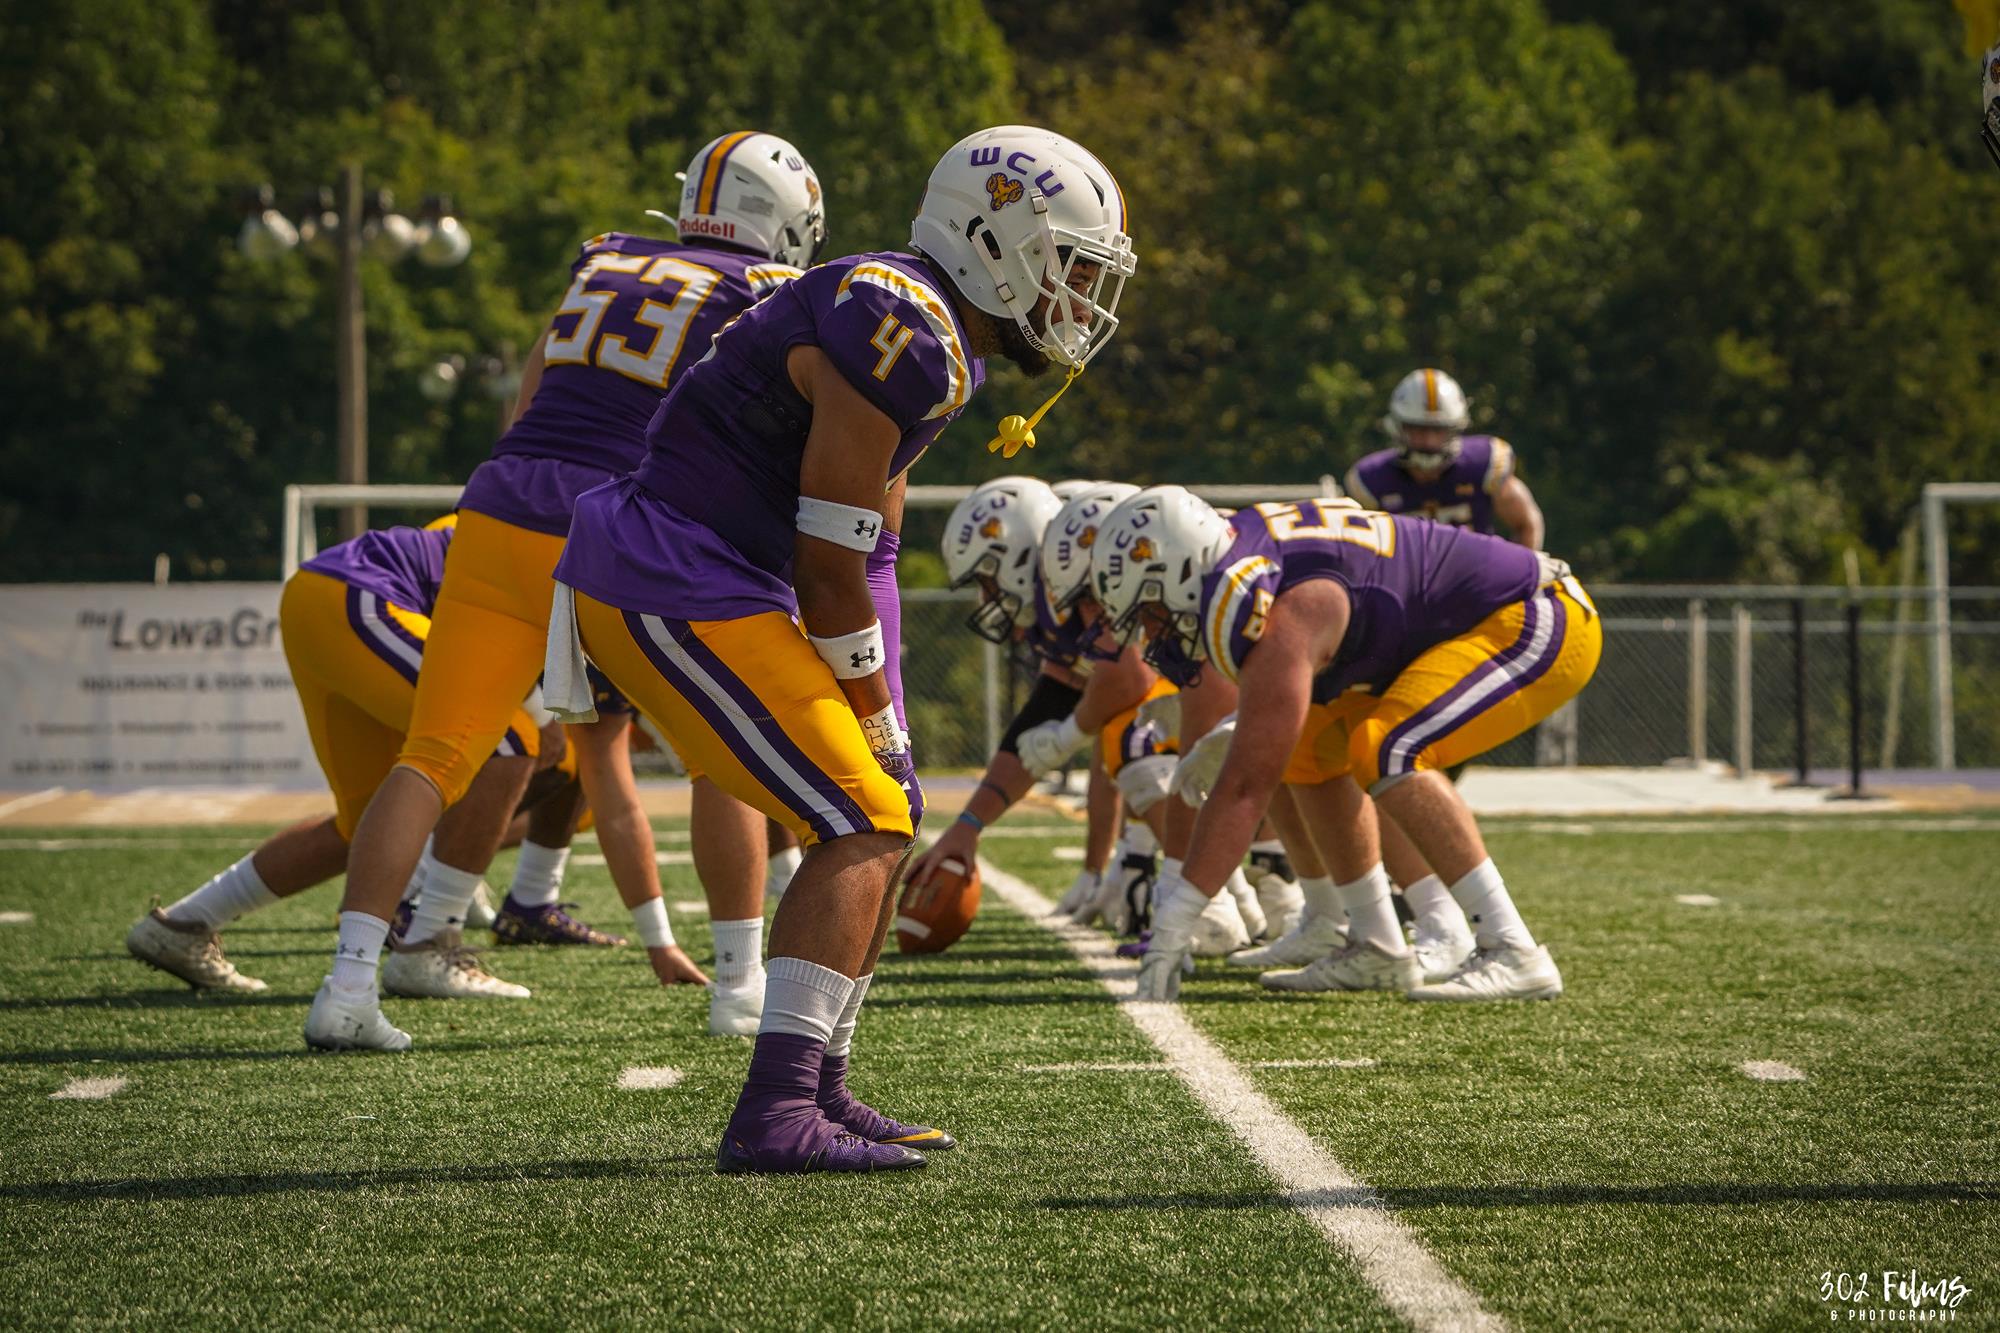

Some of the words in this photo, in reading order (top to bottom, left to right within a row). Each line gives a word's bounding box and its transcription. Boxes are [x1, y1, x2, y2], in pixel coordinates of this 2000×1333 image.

[970, 146, 1065, 198] WCU
[679, 218, 735, 239] Riddell
[544, 252, 724, 388] 53
[870, 312, 914, 382] 4
[958, 497, 1006, 545] WCU
[1058, 503, 1098, 561] WCU
[1109, 512, 1149, 576] WCU
[864, 719, 889, 753] RIP
